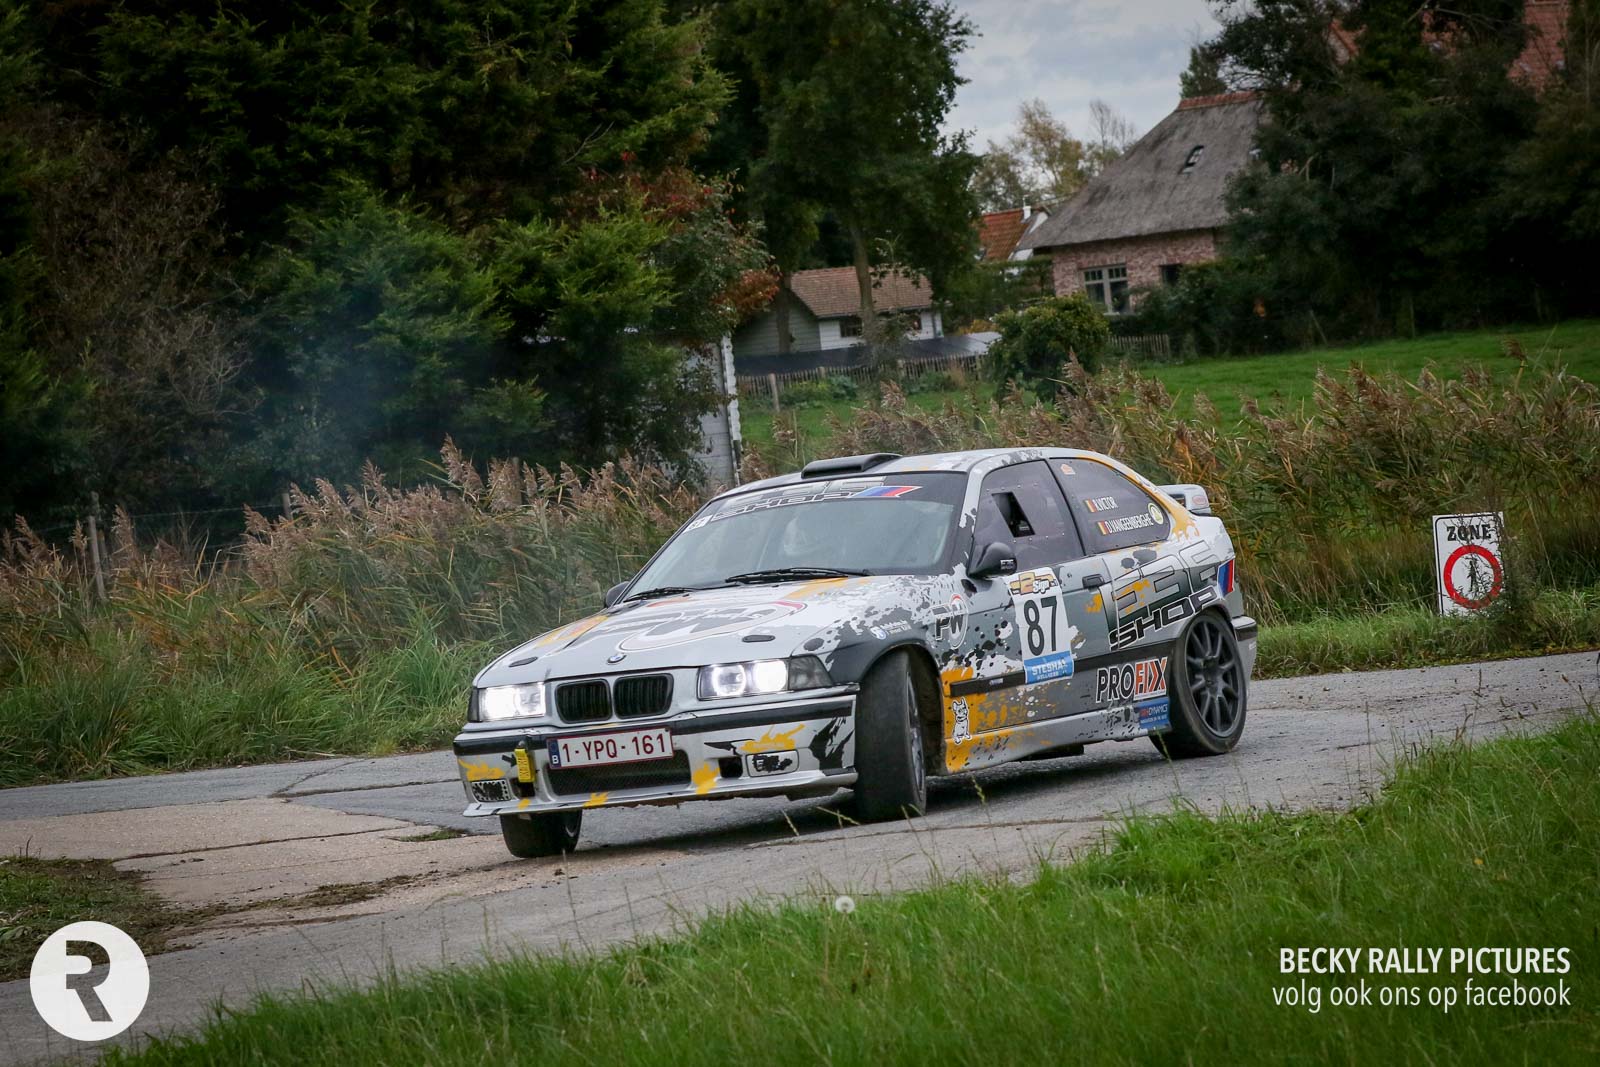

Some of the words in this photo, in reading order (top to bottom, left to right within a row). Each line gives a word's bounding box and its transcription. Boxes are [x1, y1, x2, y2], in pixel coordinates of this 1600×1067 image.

[1446, 523, 1493, 542] ZONE
[1024, 595, 1058, 656] 87
[1109, 585, 1218, 652] SHOP
[1096, 657, 1168, 703] PROFIX
[552, 755, 559, 764] B
[562, 733, 665, 762] 1-YPQ-161
